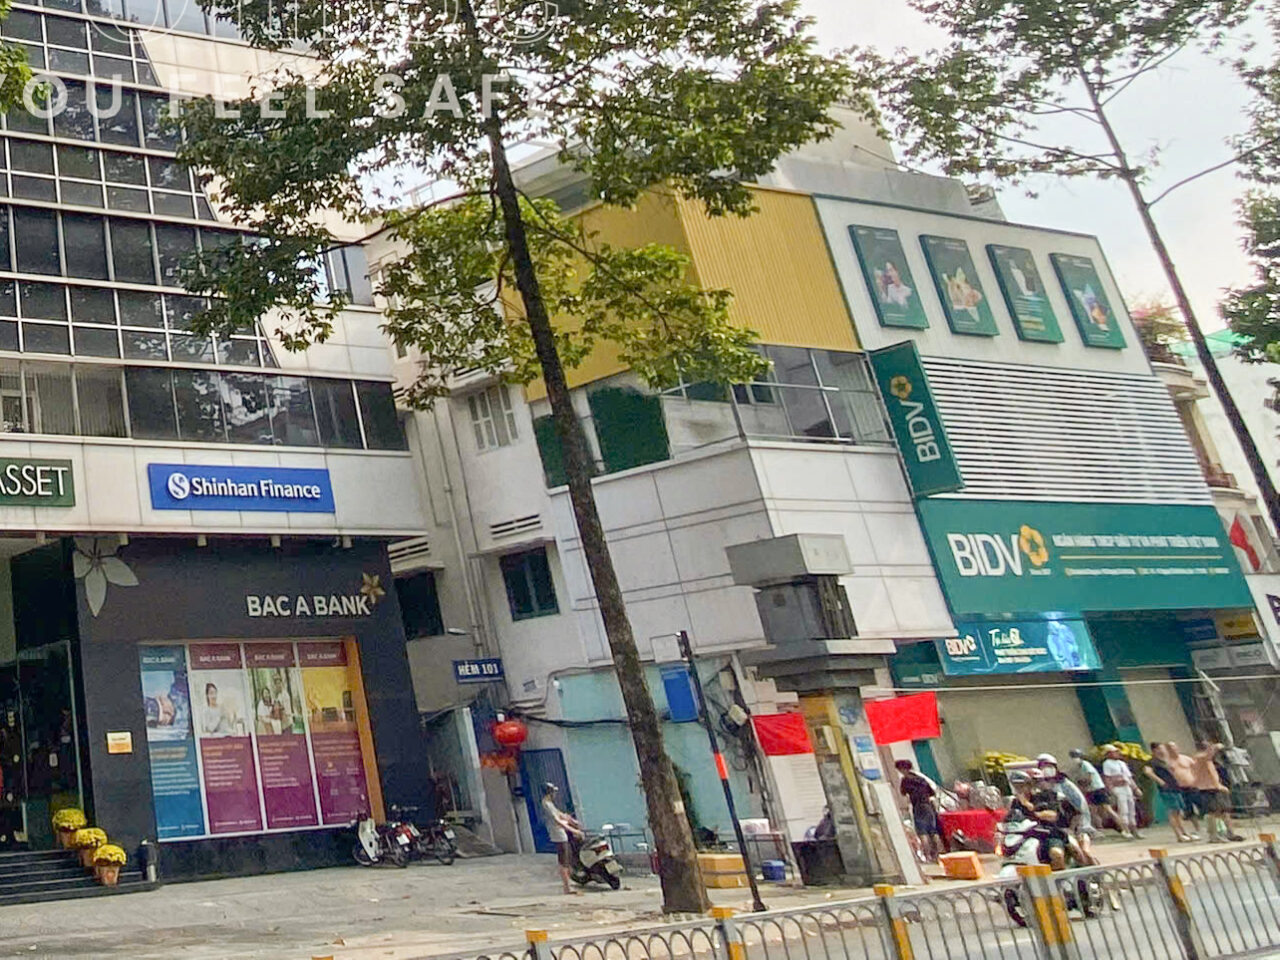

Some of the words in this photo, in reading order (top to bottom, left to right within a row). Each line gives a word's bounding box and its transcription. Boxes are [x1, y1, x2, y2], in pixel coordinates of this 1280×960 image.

[900, 399, 942, 463] BIDV
[192, 476, 258, 497] Shinhan
[260, 479, 321, 499] Finance
[947, 533, 1023, 577] BIDV
[246, 595, 292, 617] BAC
[295, 595, 311, 617] A
[313, 595, 371, 617] BANK
[481, 663, 499, 675] 101
